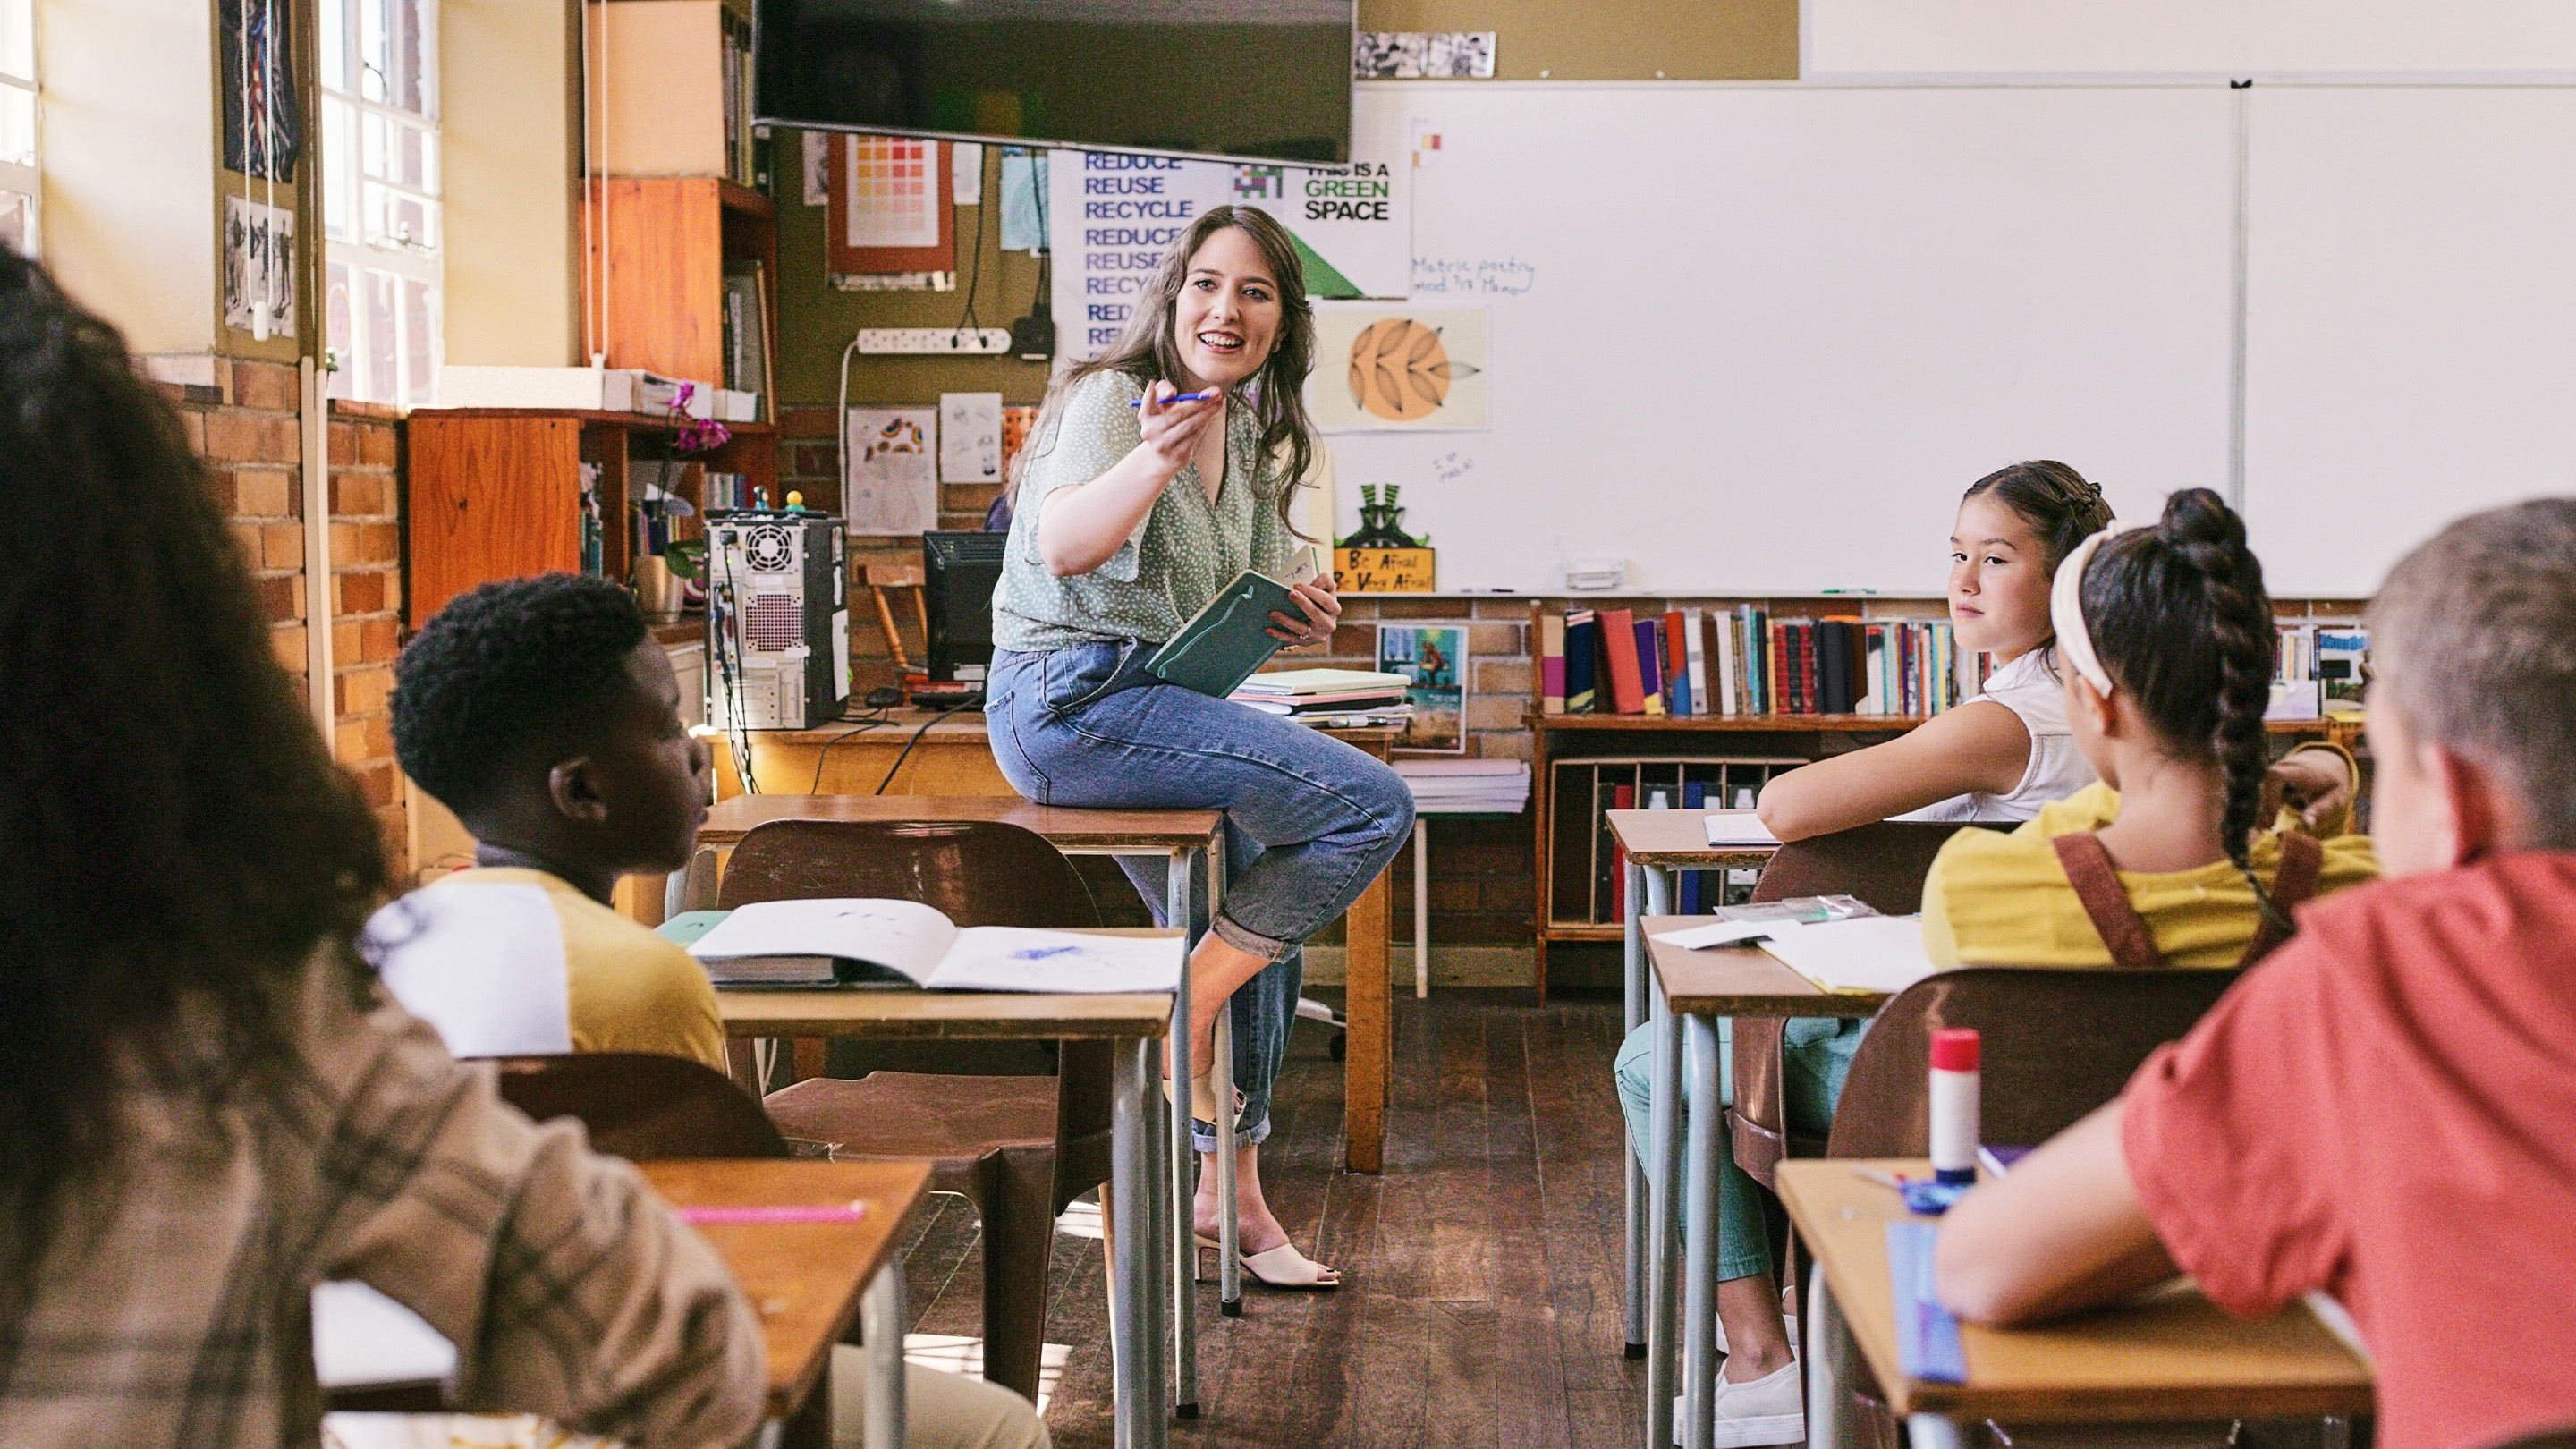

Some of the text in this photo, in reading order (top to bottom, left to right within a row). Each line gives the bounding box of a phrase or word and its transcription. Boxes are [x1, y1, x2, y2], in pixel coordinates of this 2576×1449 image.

[1085, 152, 1182, 170] REDUCE
[1354, 163, 1371, 176] IS
[1377, 163, 1389, 176] A
[1085, 176, 1165, 194] REUSE
[1305, 180, 1389, 198] GREEN
[1085, 200, 1193, 218] RECYCLE
[1305, 200, 1389, 220] SPACE
[1086, 276, 1149, 294] RECY
[1087, 304, 1132, 321] RED
